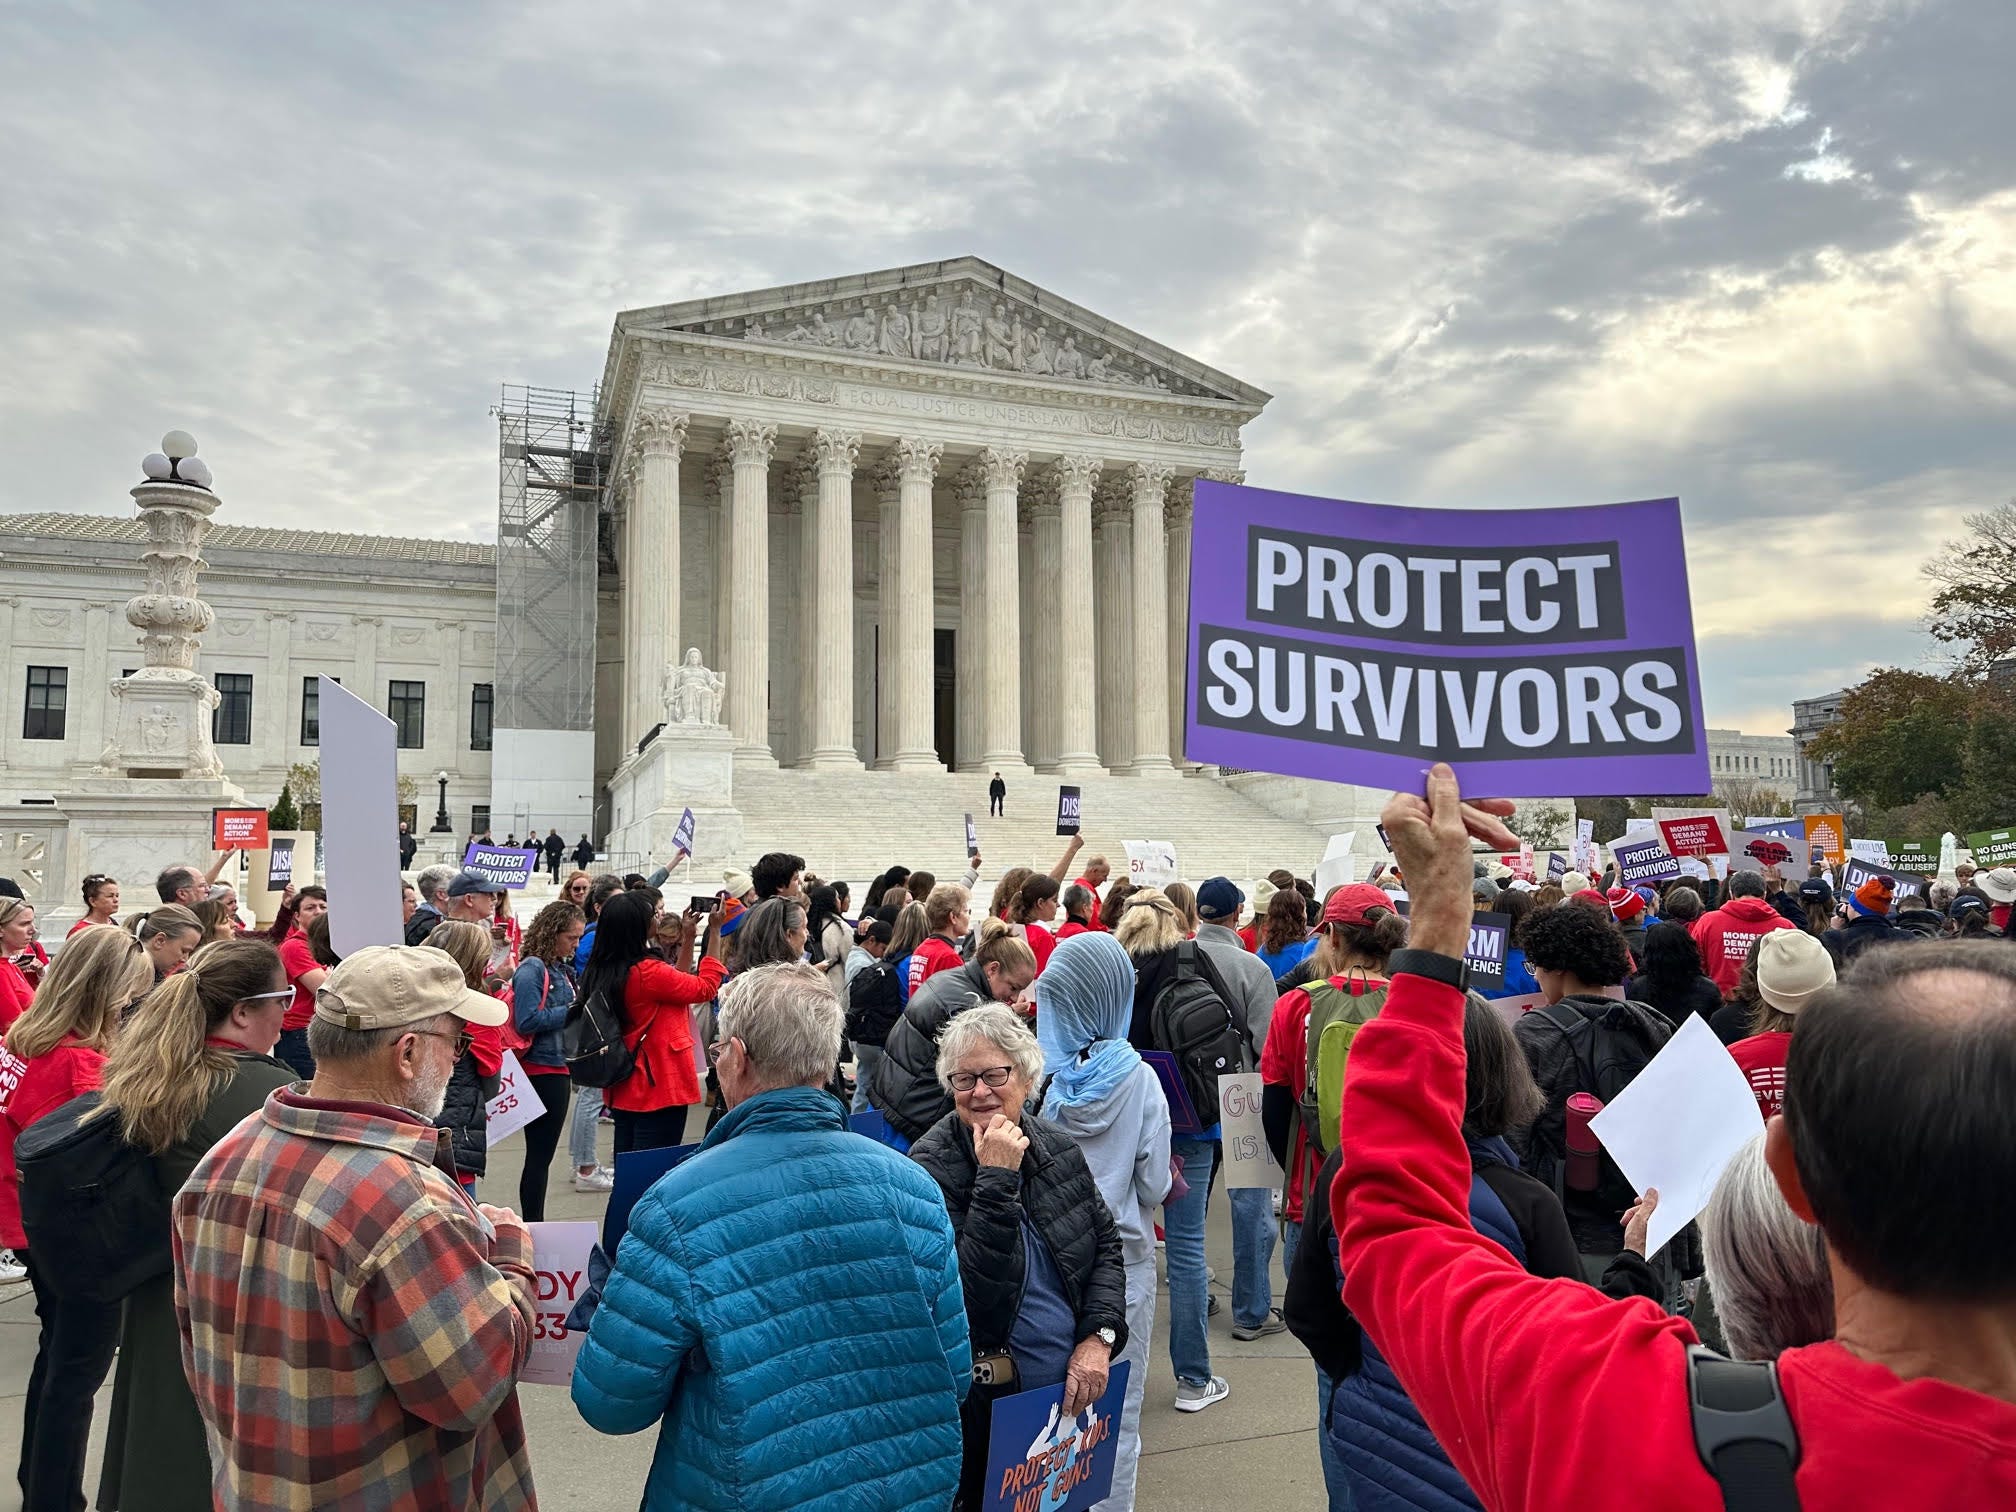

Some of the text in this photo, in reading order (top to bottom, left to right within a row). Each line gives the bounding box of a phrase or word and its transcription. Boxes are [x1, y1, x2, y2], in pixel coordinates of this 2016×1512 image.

[850, 390, 1073, 426] EQUAL JUSTICE UNDER LAW
[1257, 537, 1612, 633] PROTECT
[1205, 639, 1682, 749] SURVIVORS
[1669, 825, 1695, 833] MOMS
[1672, 830, 1708, 839] DEMAND
[1676, 837, 1706, 846] ACTION
[1625, 846, 1667, 865] PROTEC
[1976, 846, 1990, 855] NO
[475, 851, 526, 868] PROTECT
[1900, 854, 1927, 862] GUNS
[1979, 855, 1990, 864] DV
[1132, 859, 1145, 873] 5X
[1623, 858, 1678, 881] SURVIVORS
[1897, 863, 1938, 871] ABUSERS
[1723, 931, 1756, 941] MOMS
[1724, 947, 1750, 956] ACTI
[1232, 1135, 1259, 1161] IS
[1000, 1414, 1112, 1500] PROTECT KIDS.
[1013, 1456, 1094, 1512] NOT GUNS.
